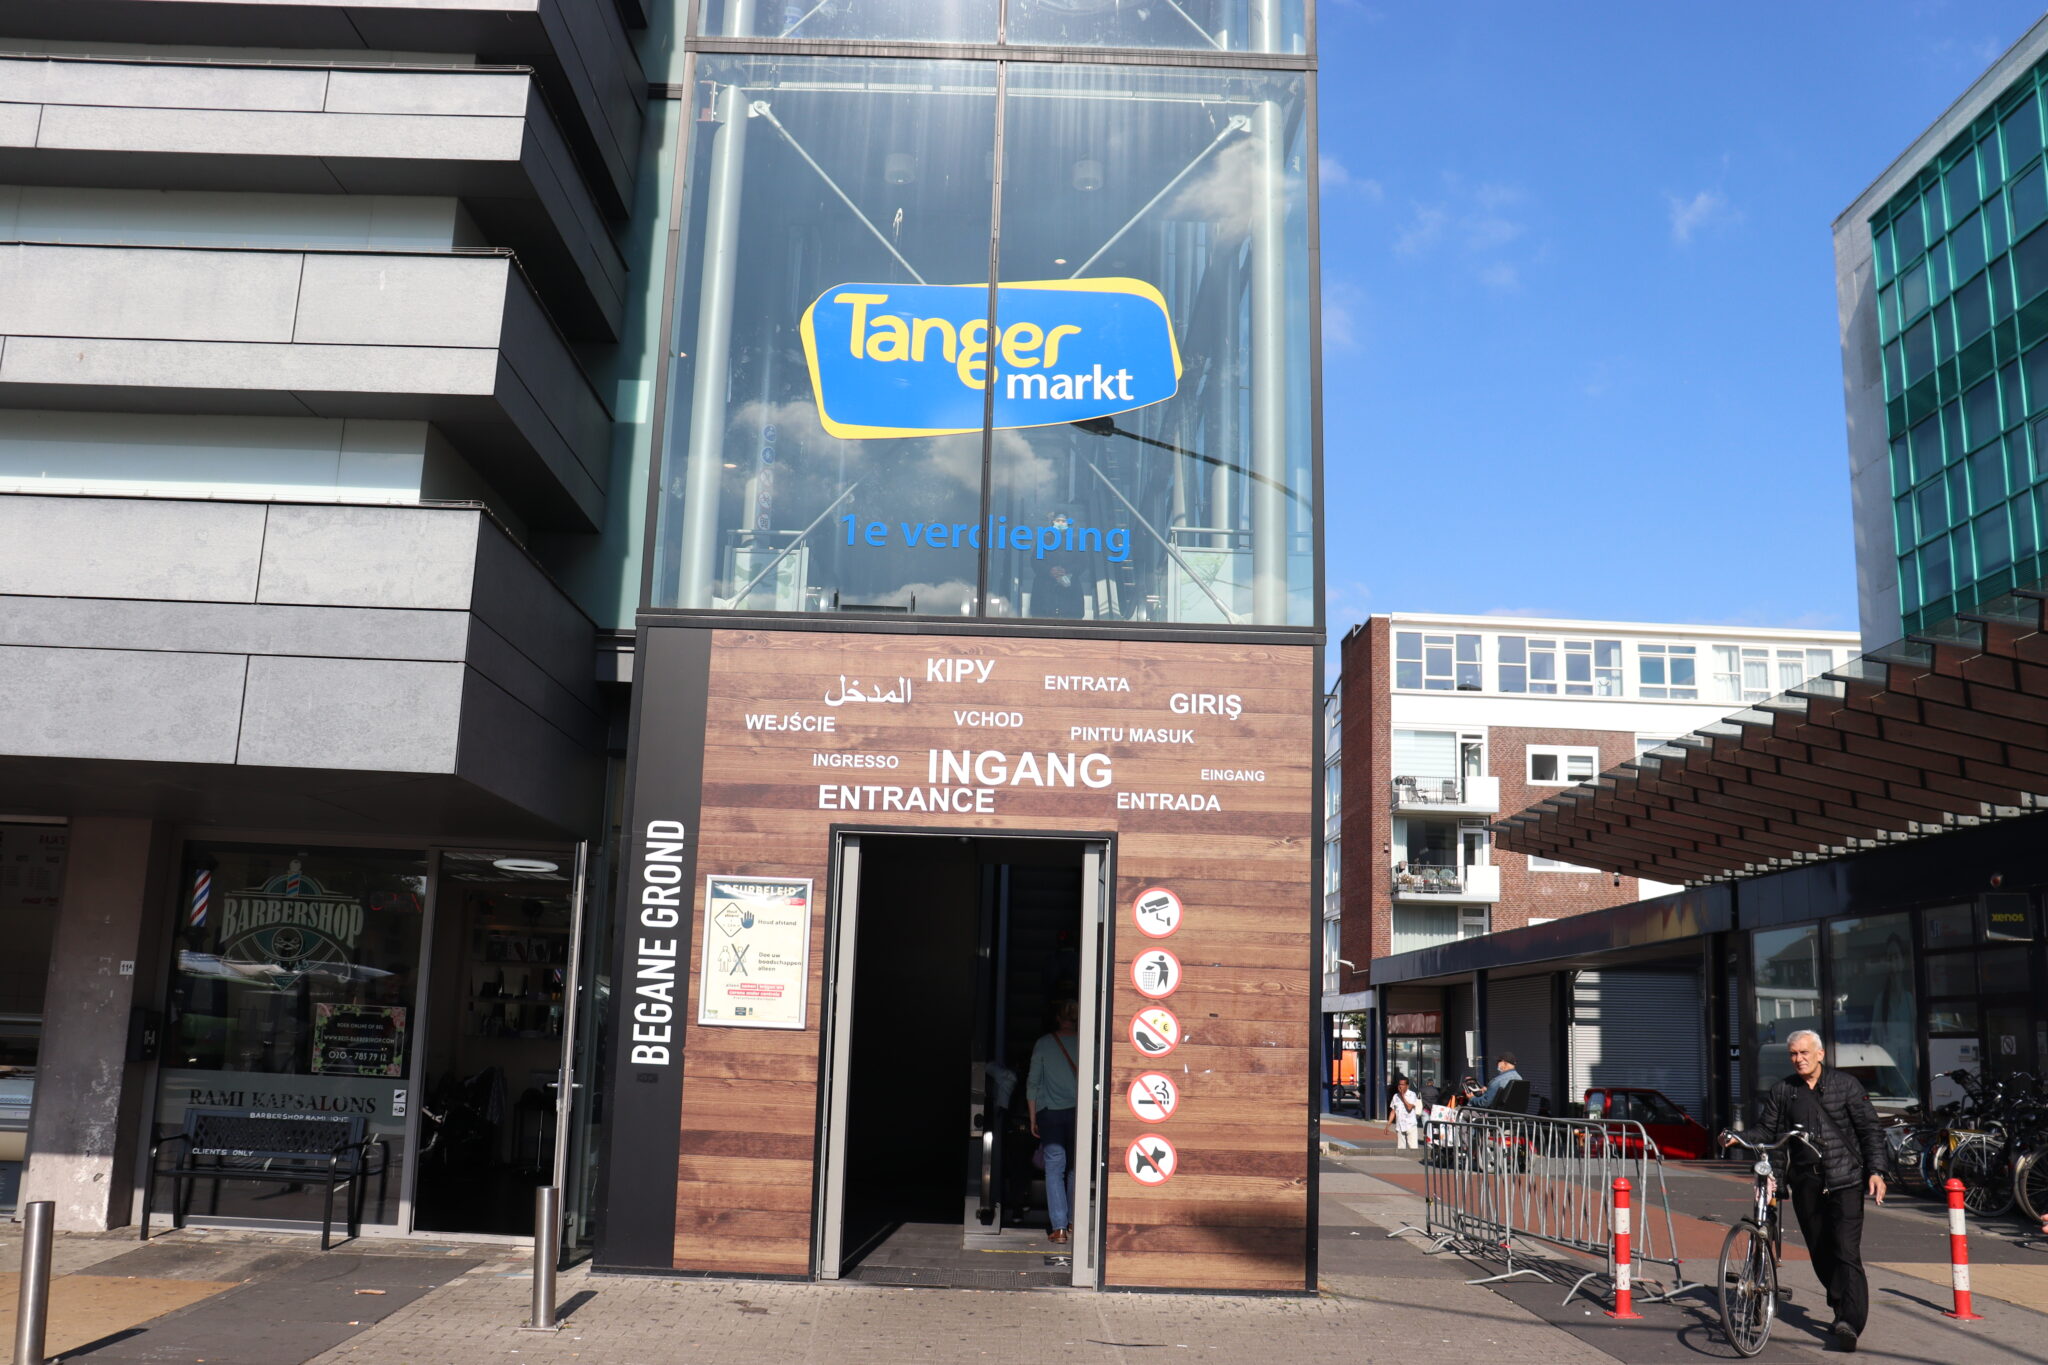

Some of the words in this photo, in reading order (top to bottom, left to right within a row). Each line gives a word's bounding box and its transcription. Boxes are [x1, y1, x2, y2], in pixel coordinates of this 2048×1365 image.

[833, 293, 1081, 389] Tanger
[1007, 364, 1134, 400] markt
[842, 514, 888, 546] 1e
[901, 515, 1130, 562] verdieping
[825, 675, 911, 706] المدخل
[1044, 675, 1130, 692] ENTRATA
[1170, 693, 1242, 720] GIRIŞ
[745, 711, 835, 732] WEJŚCIE
[953, 711, 1023, 728] VCHOD
[1070, 727, 1123, 742] PINTU
[1129, 728, 1194, 744] MASUK
[813, 753, 898, 769] INGRESSO
[928, 749, 1112, 788] INGANG
[1201, 769, 1265, 782] EINGANG
[819, 786, 995, 813] ENTRANCE
[1117, 792, 1221, 812] ENTRADA
[641, 820, 685, 928] GROND
[218, 899, 364, 949] BARBERSHOP
[1991, 913, 2024, 922] xenos
[631, 938, 677, 1065] BEGANE
[188, 1089, 244, 1107] RAMI
[252, 1092, 376, 1113] KAPSALONS
[250, 1112, 305, 1121] BARBERSHOP
[305, 1113, 326, 1121] RAMI
[192, 1148, 227, 1156] CLIENTS
[232, 1149, 254, 1157] ONLY
